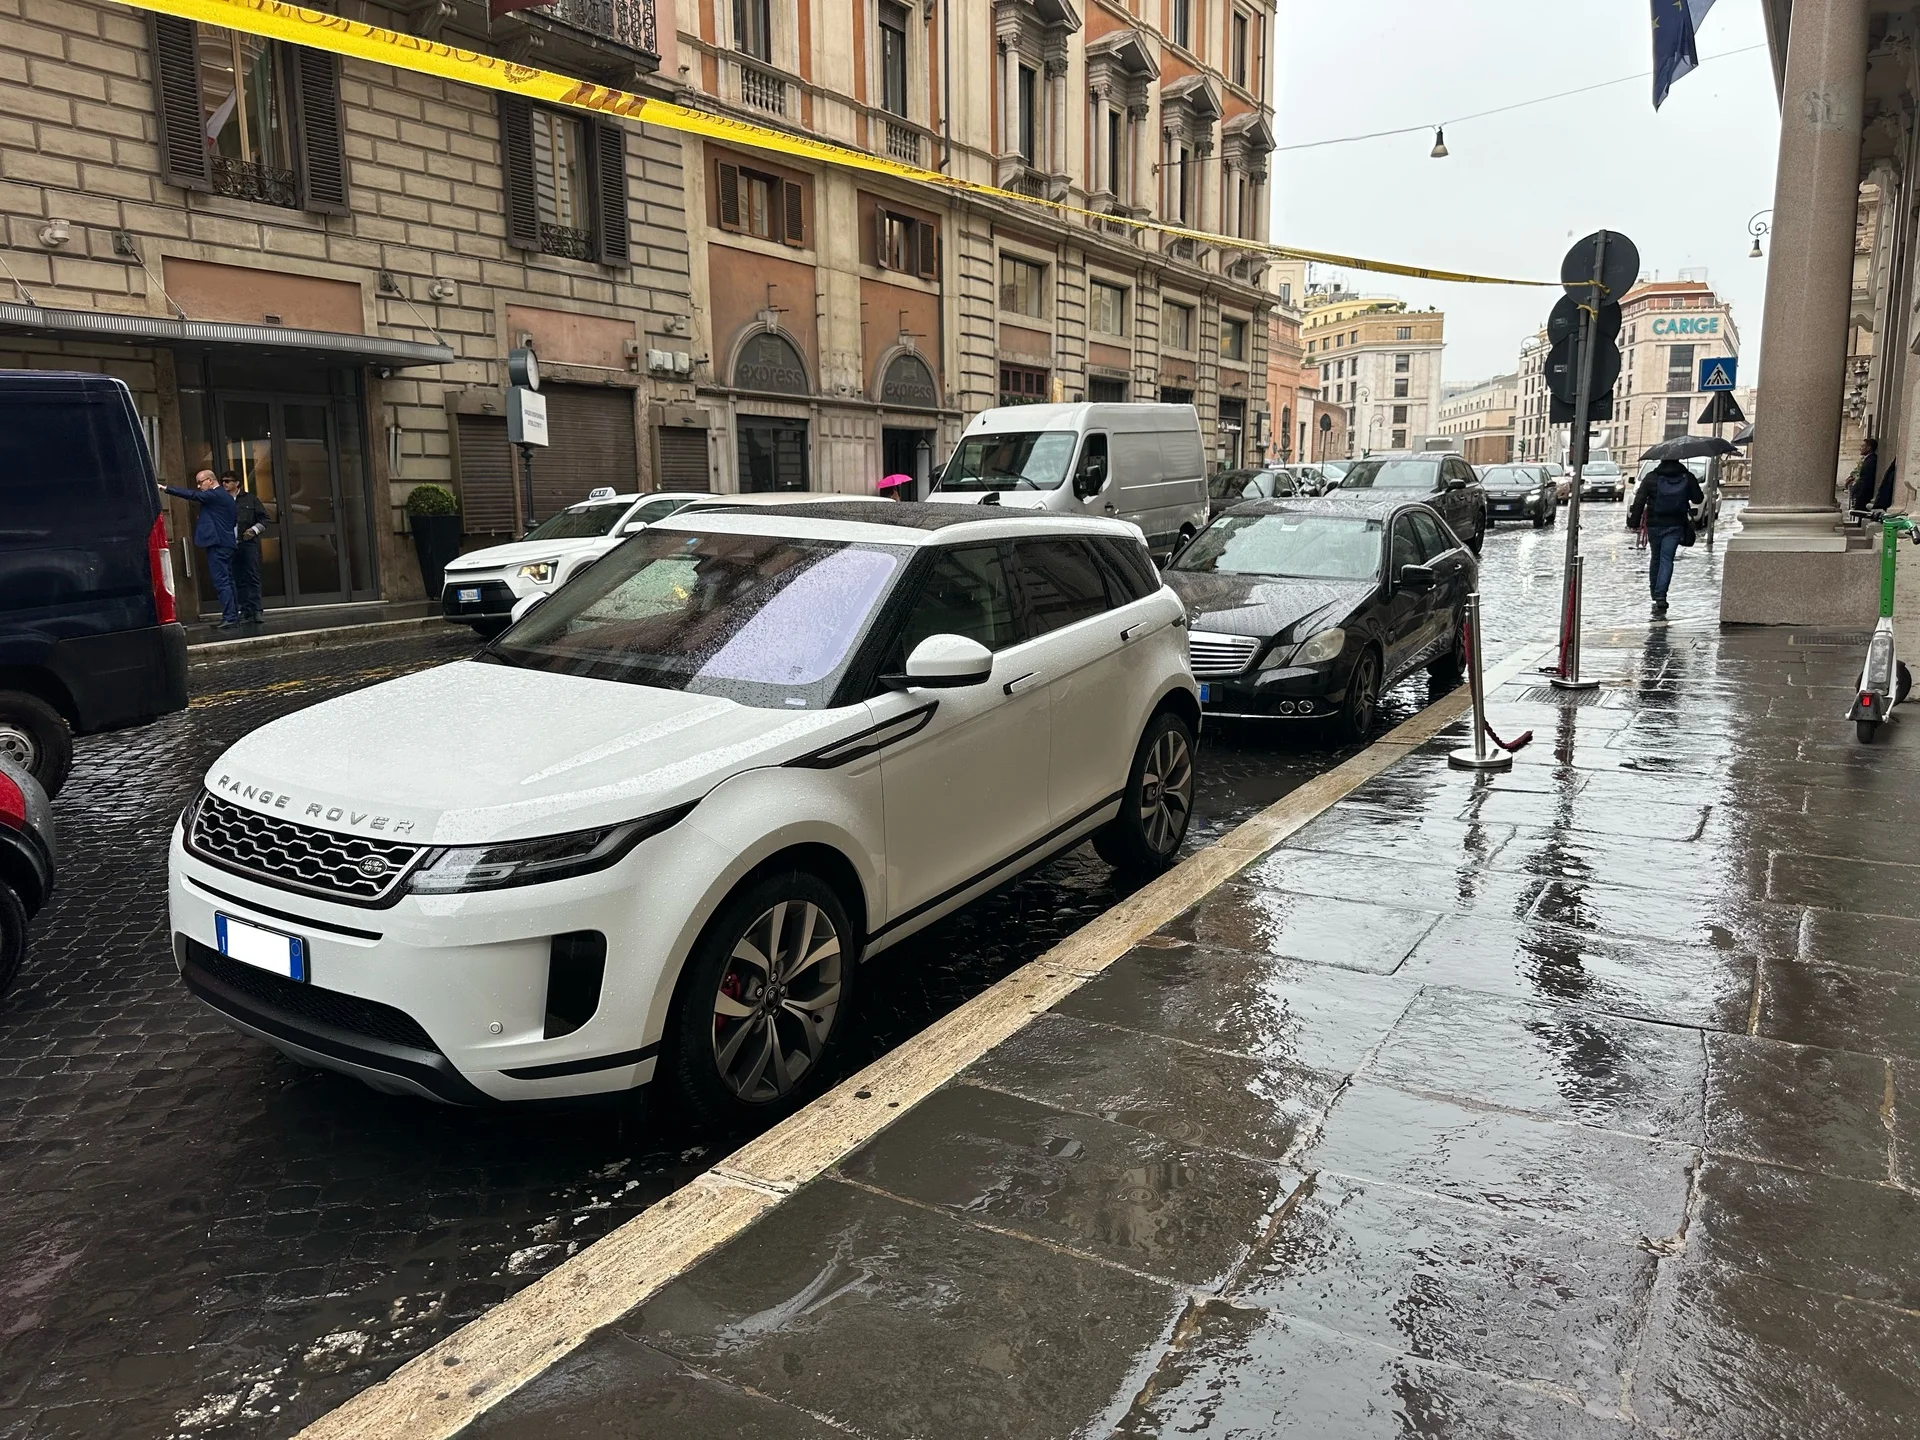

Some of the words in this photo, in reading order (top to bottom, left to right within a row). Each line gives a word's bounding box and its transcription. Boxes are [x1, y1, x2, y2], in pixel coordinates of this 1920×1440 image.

[1652, 317, 1719, 335] CARIGE
[739, 362, 801, 386] express
[884, 380, 932, 400] express
[217, 774, 291, 809] RANGE
[305, 802, 415, 835] ROVER
